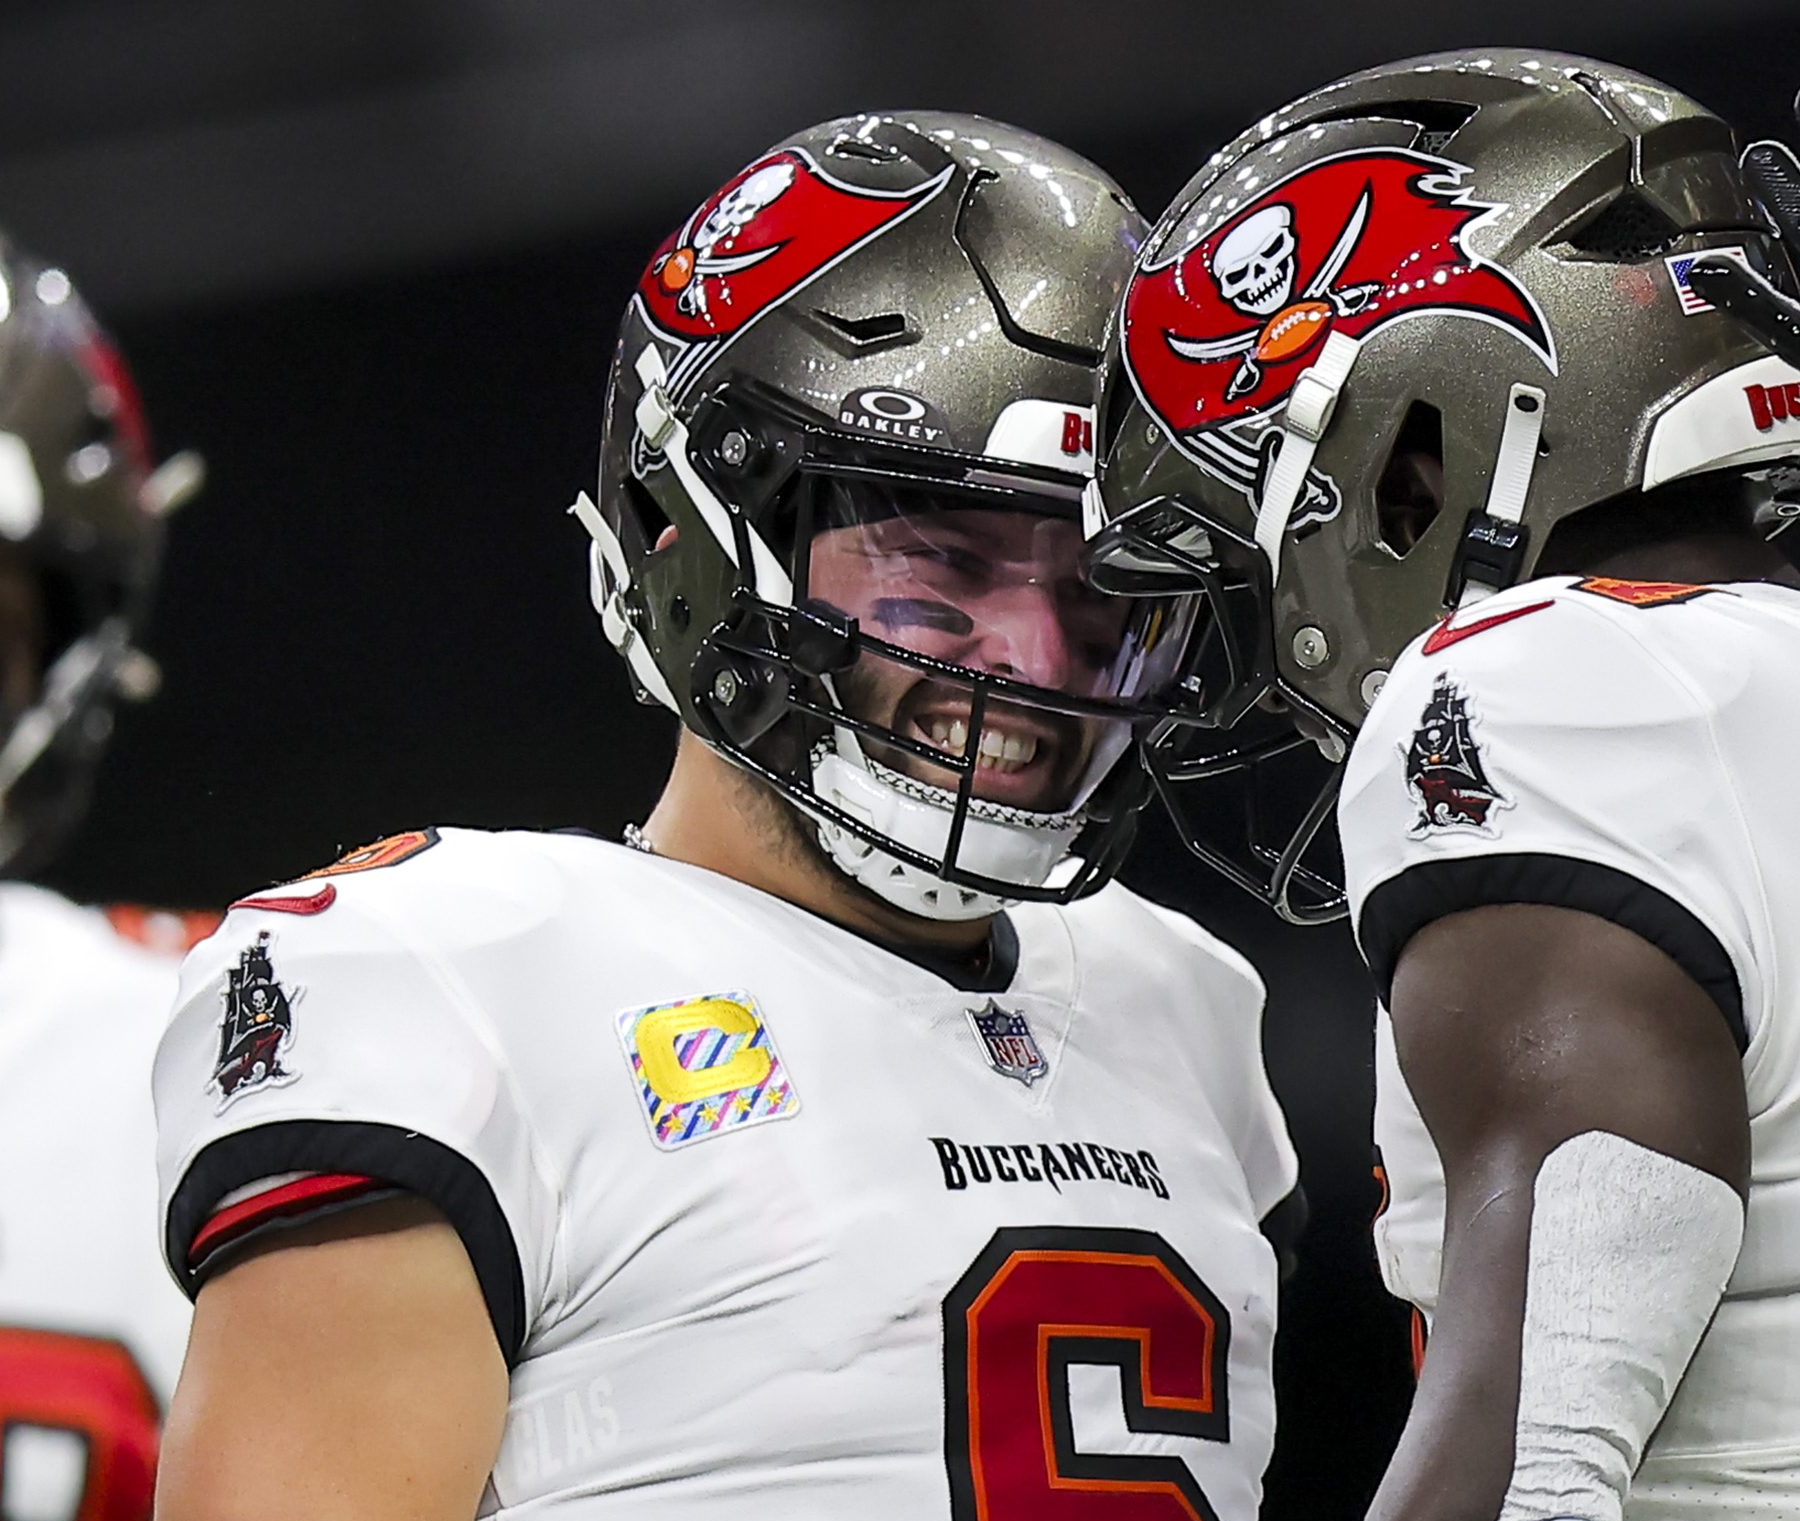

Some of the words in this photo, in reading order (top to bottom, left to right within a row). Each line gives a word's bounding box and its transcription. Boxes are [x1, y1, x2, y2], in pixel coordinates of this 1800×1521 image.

[841, 411, 943, 441] OAKLEY
[636, 999, 772, 1104] C
[988, 1037, 1038, 1068] NFL
[928, 1137, 1171, 1200] BUCCANEERS
